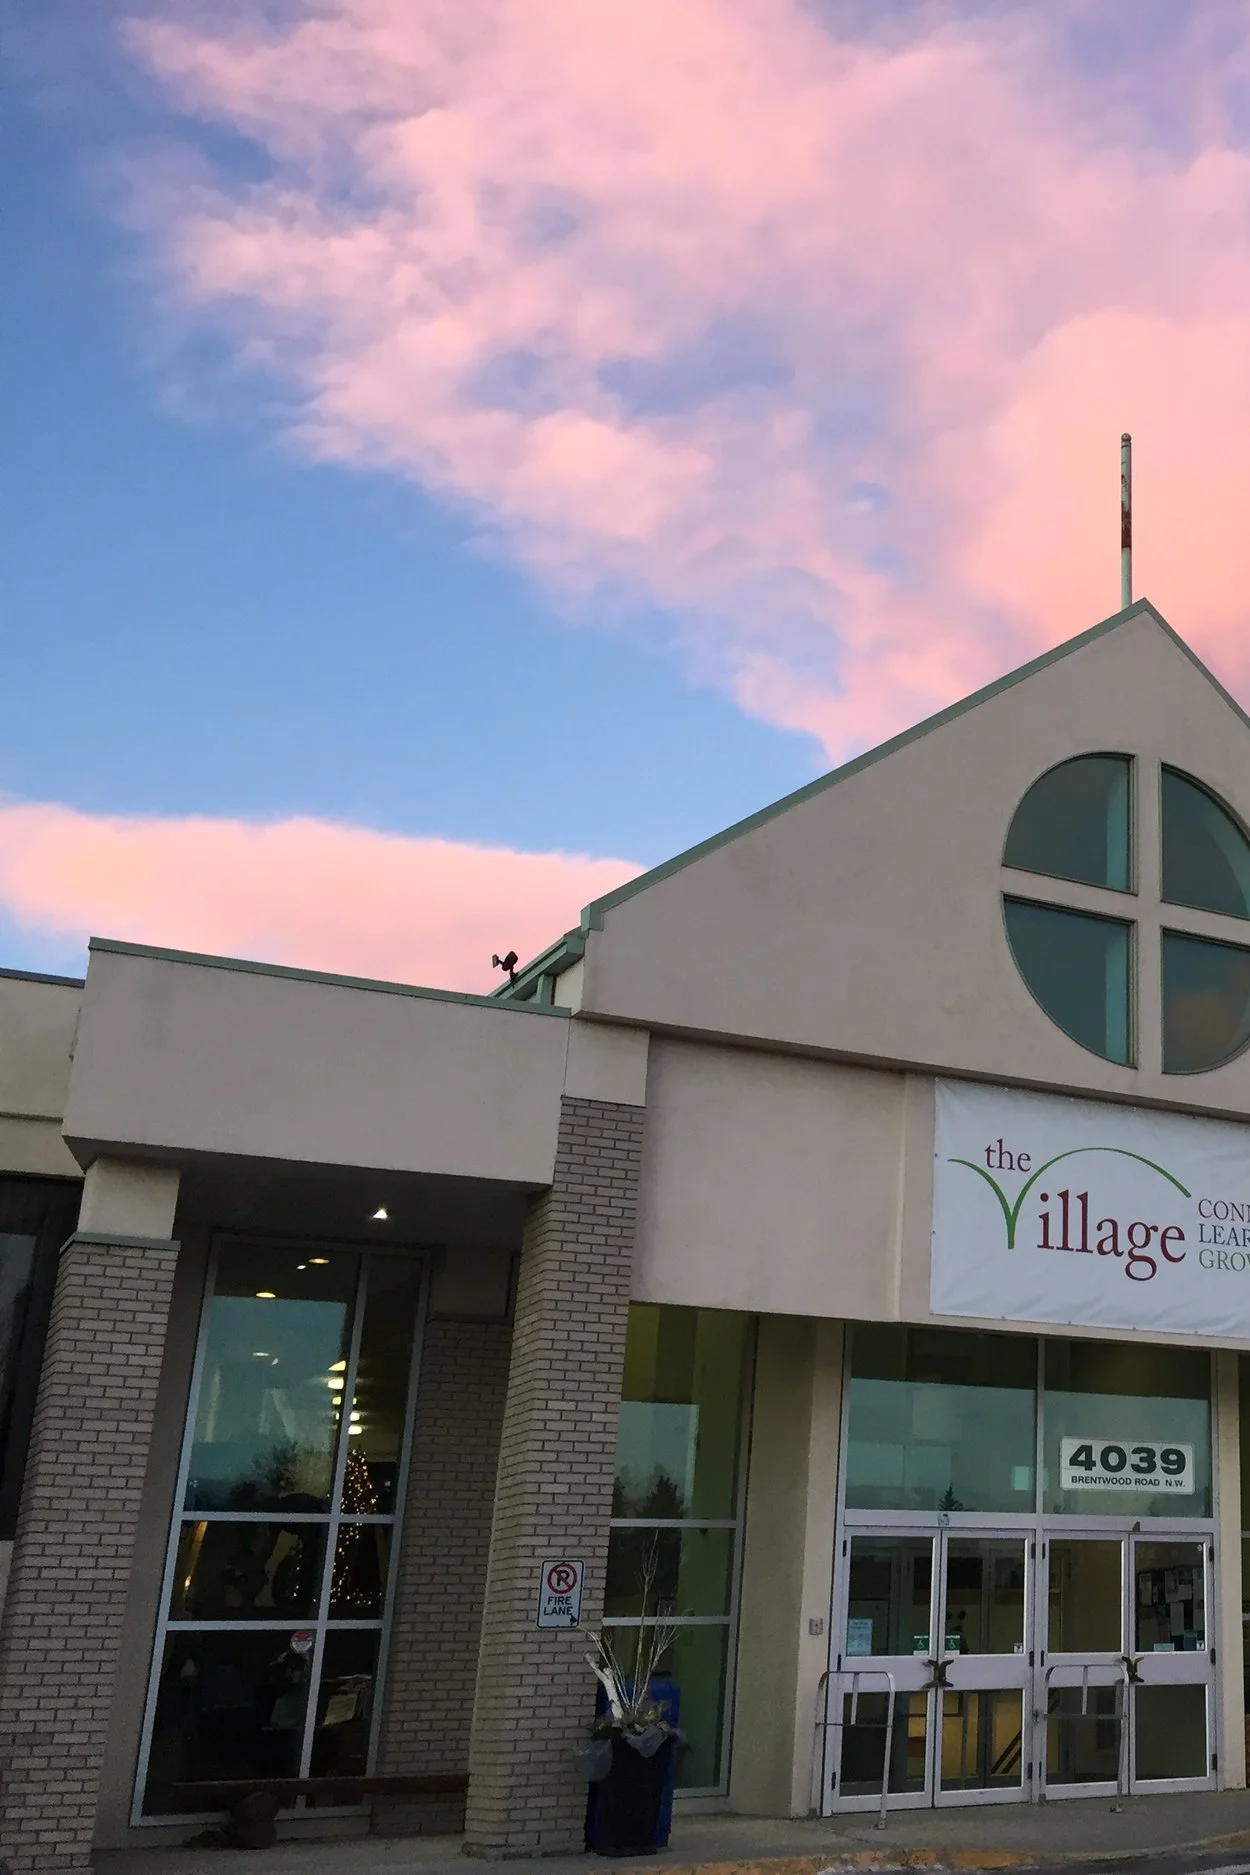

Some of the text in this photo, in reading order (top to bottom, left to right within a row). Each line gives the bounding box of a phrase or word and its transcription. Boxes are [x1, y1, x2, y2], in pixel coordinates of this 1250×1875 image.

[984, 1138, 1031, 1172] the
[1069, 1444, 1186, 1475] 4039
[1071, 1475, 1132, 1486] BRENTWOOD
[1134, 1477, 1160, 1487] ROAD
[547, 1596, 572, 1606] FIRE
[543, 1606, 573, 1616] LANE
